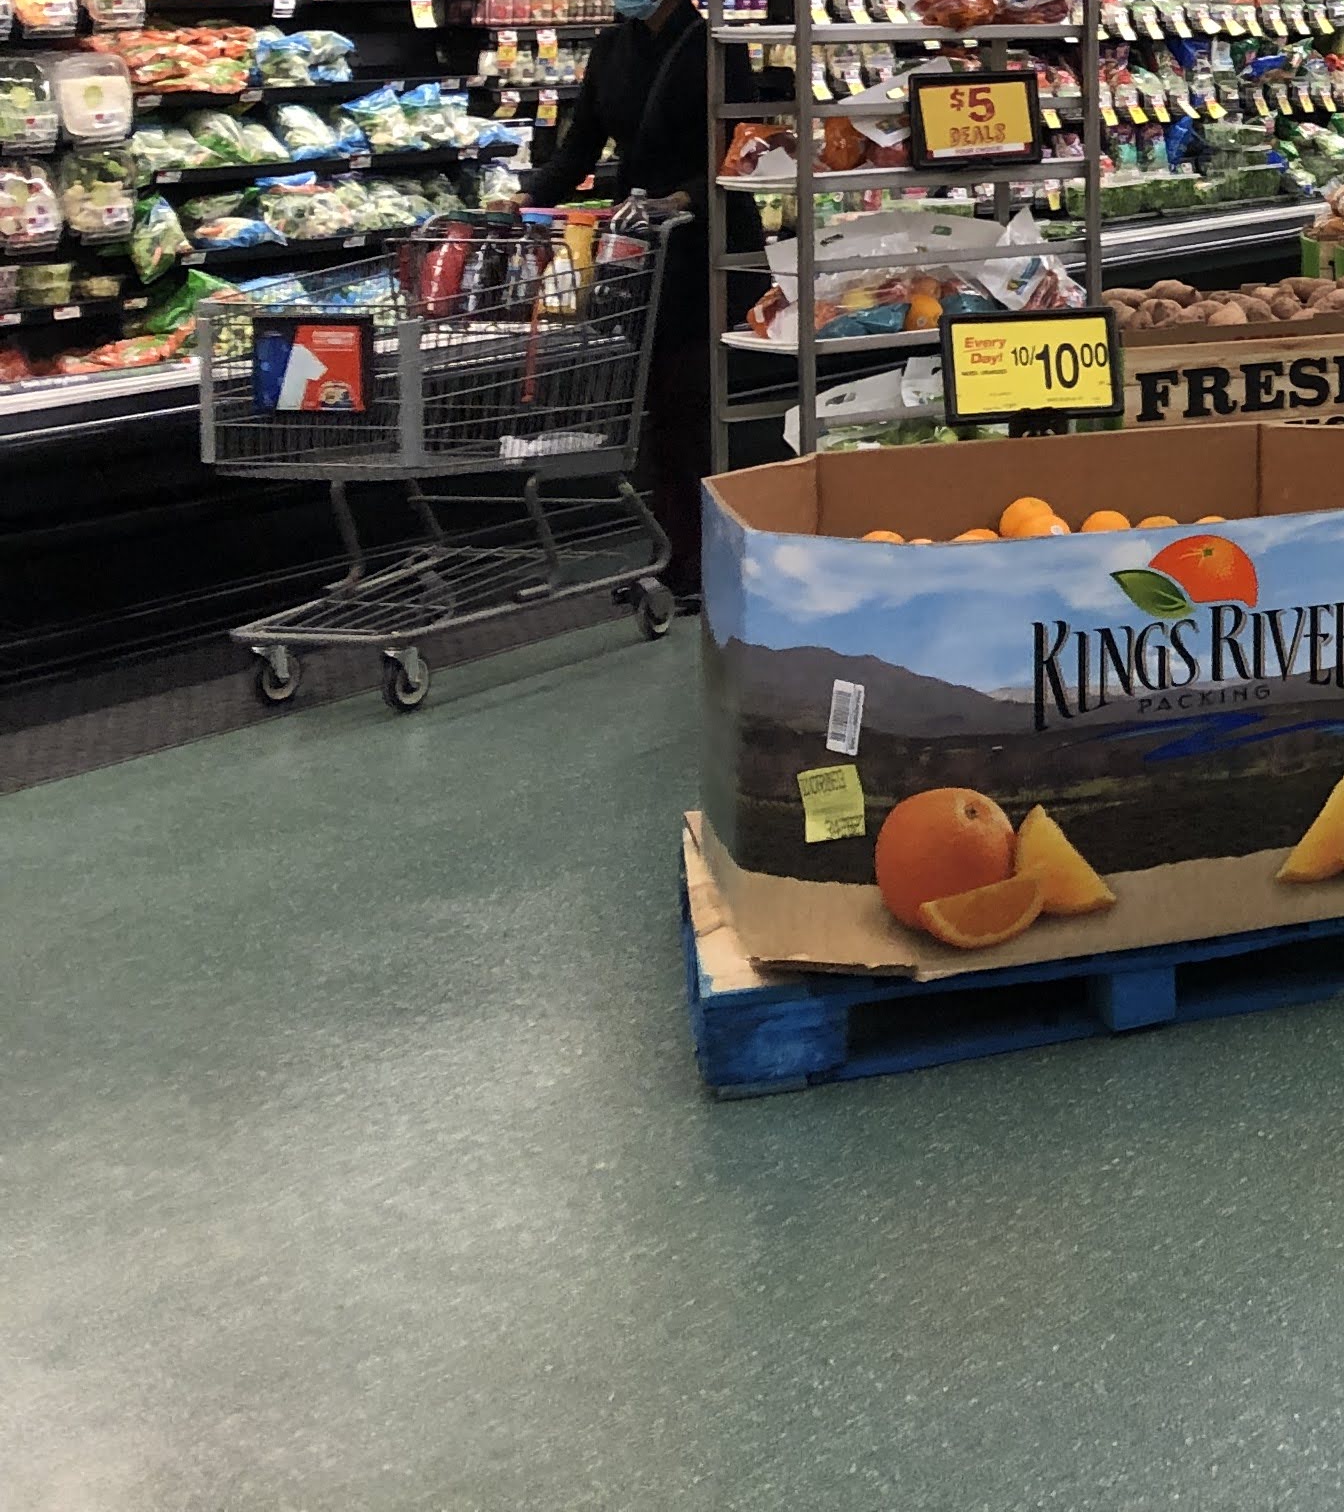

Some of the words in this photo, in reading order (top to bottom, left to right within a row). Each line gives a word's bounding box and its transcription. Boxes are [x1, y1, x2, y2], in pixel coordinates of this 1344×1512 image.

[950, 87, 995, 122] $5
[948, 123, 1006, 147] DEALS
[964, 337, 1006, 349] Every
[970, 352, 1003, 366] Day!
[1032, 618, 1199, 731] KINGS
[1138, 686, 1271, 714] PACKING
